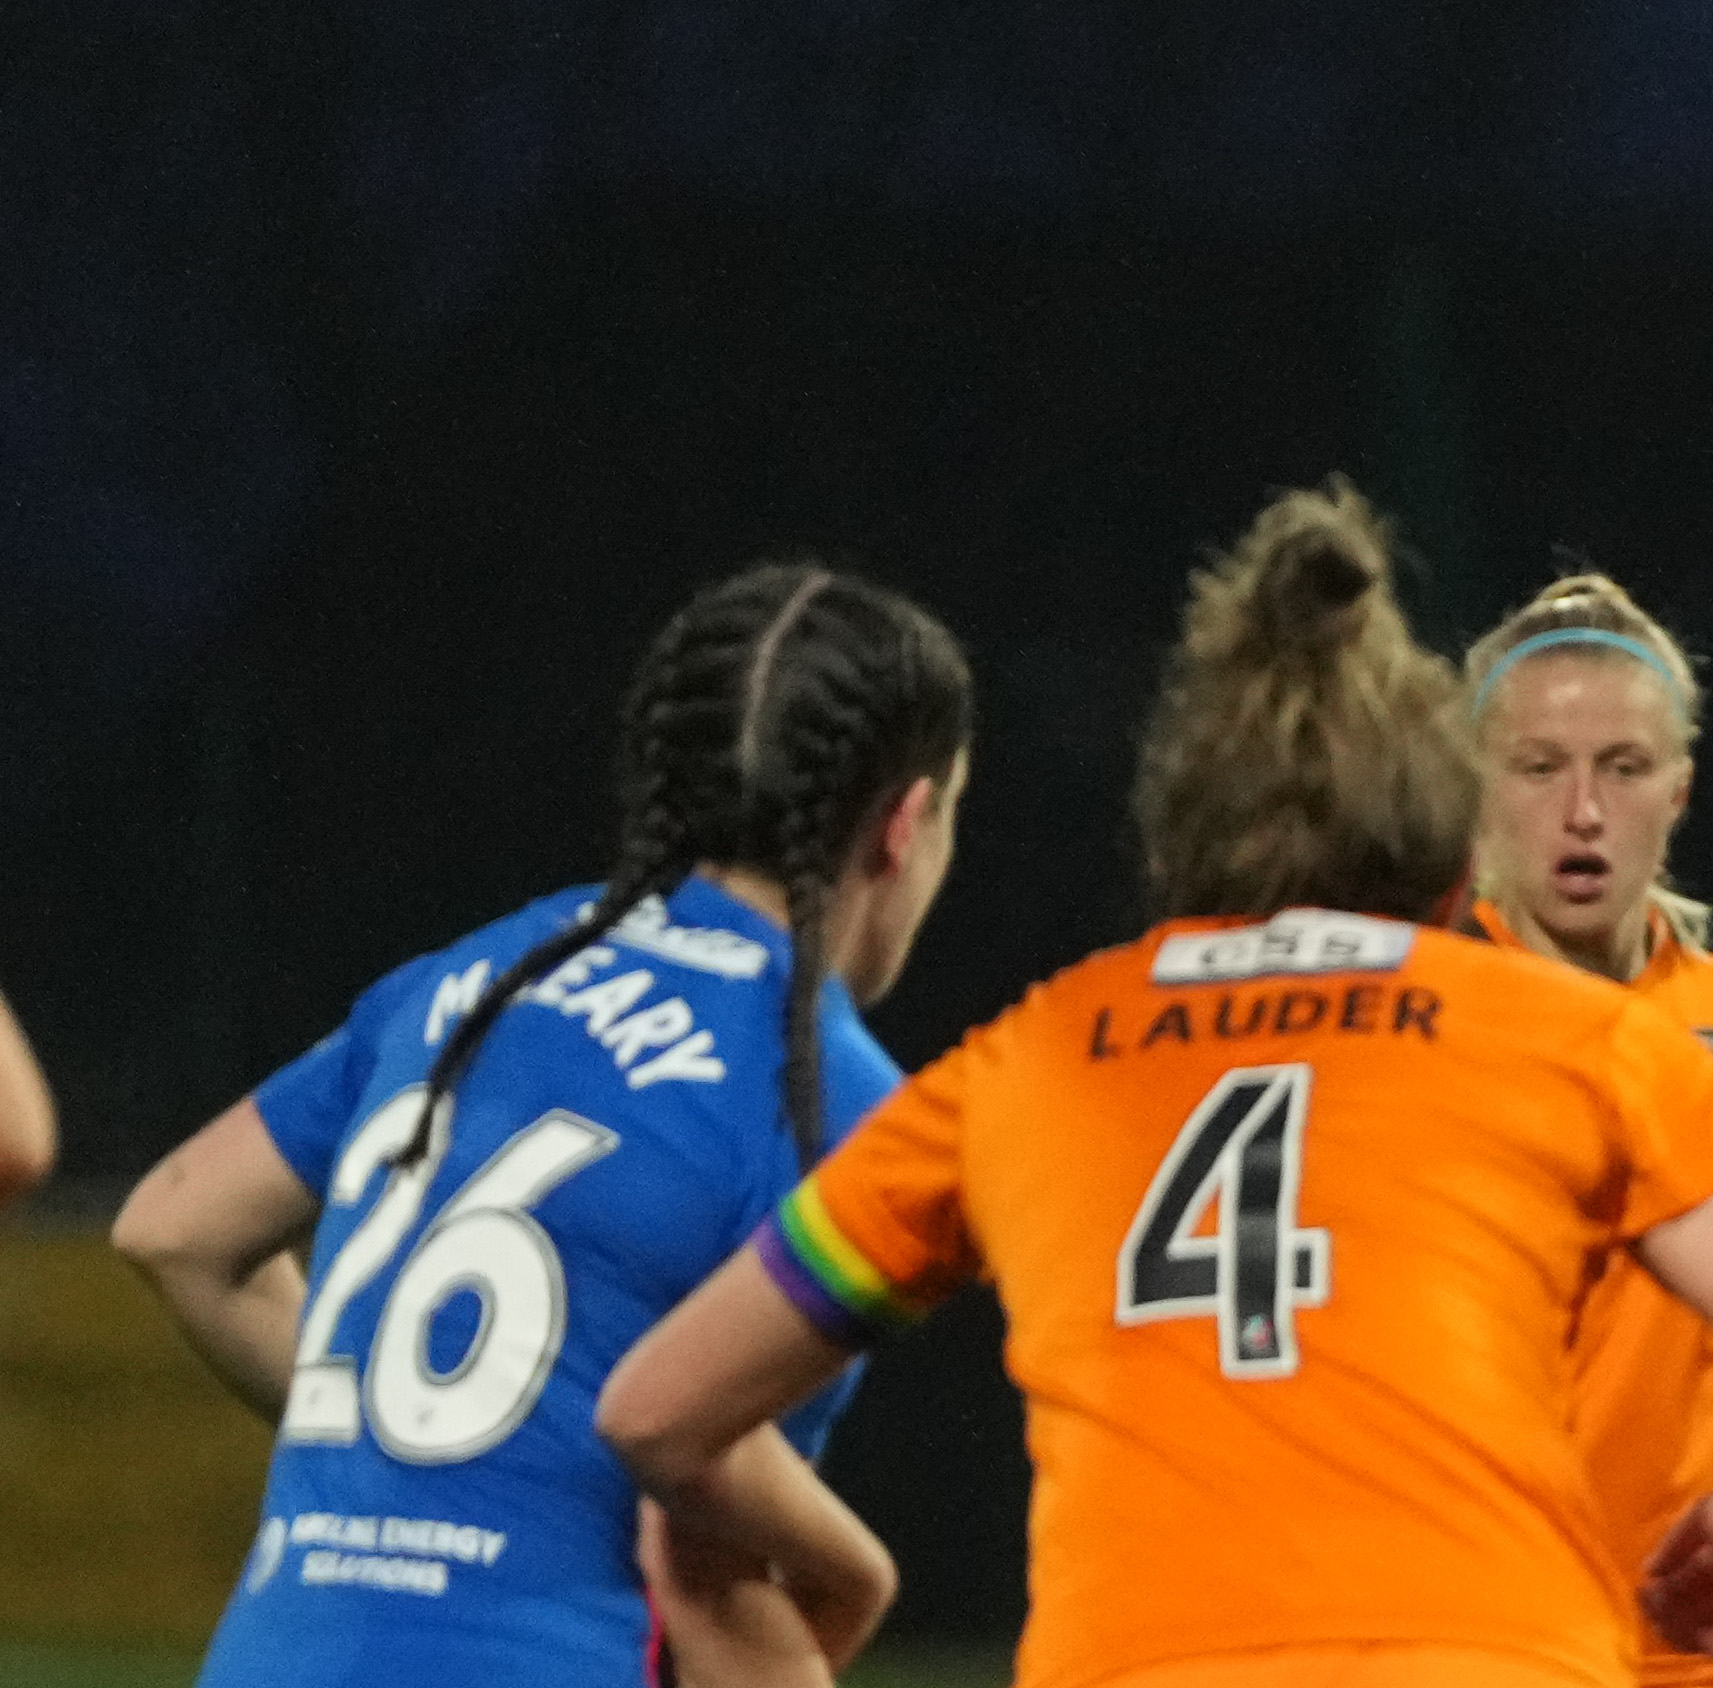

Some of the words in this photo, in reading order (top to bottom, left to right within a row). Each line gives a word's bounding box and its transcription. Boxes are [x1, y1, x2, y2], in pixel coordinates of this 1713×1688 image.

[424, 944, 728, 1091] MEARY
[1088, 983, 1444, 1064] LAUDER
[280, 1081, 621, 1466] 26
[1115, 1061, 1331, 1379] 4
